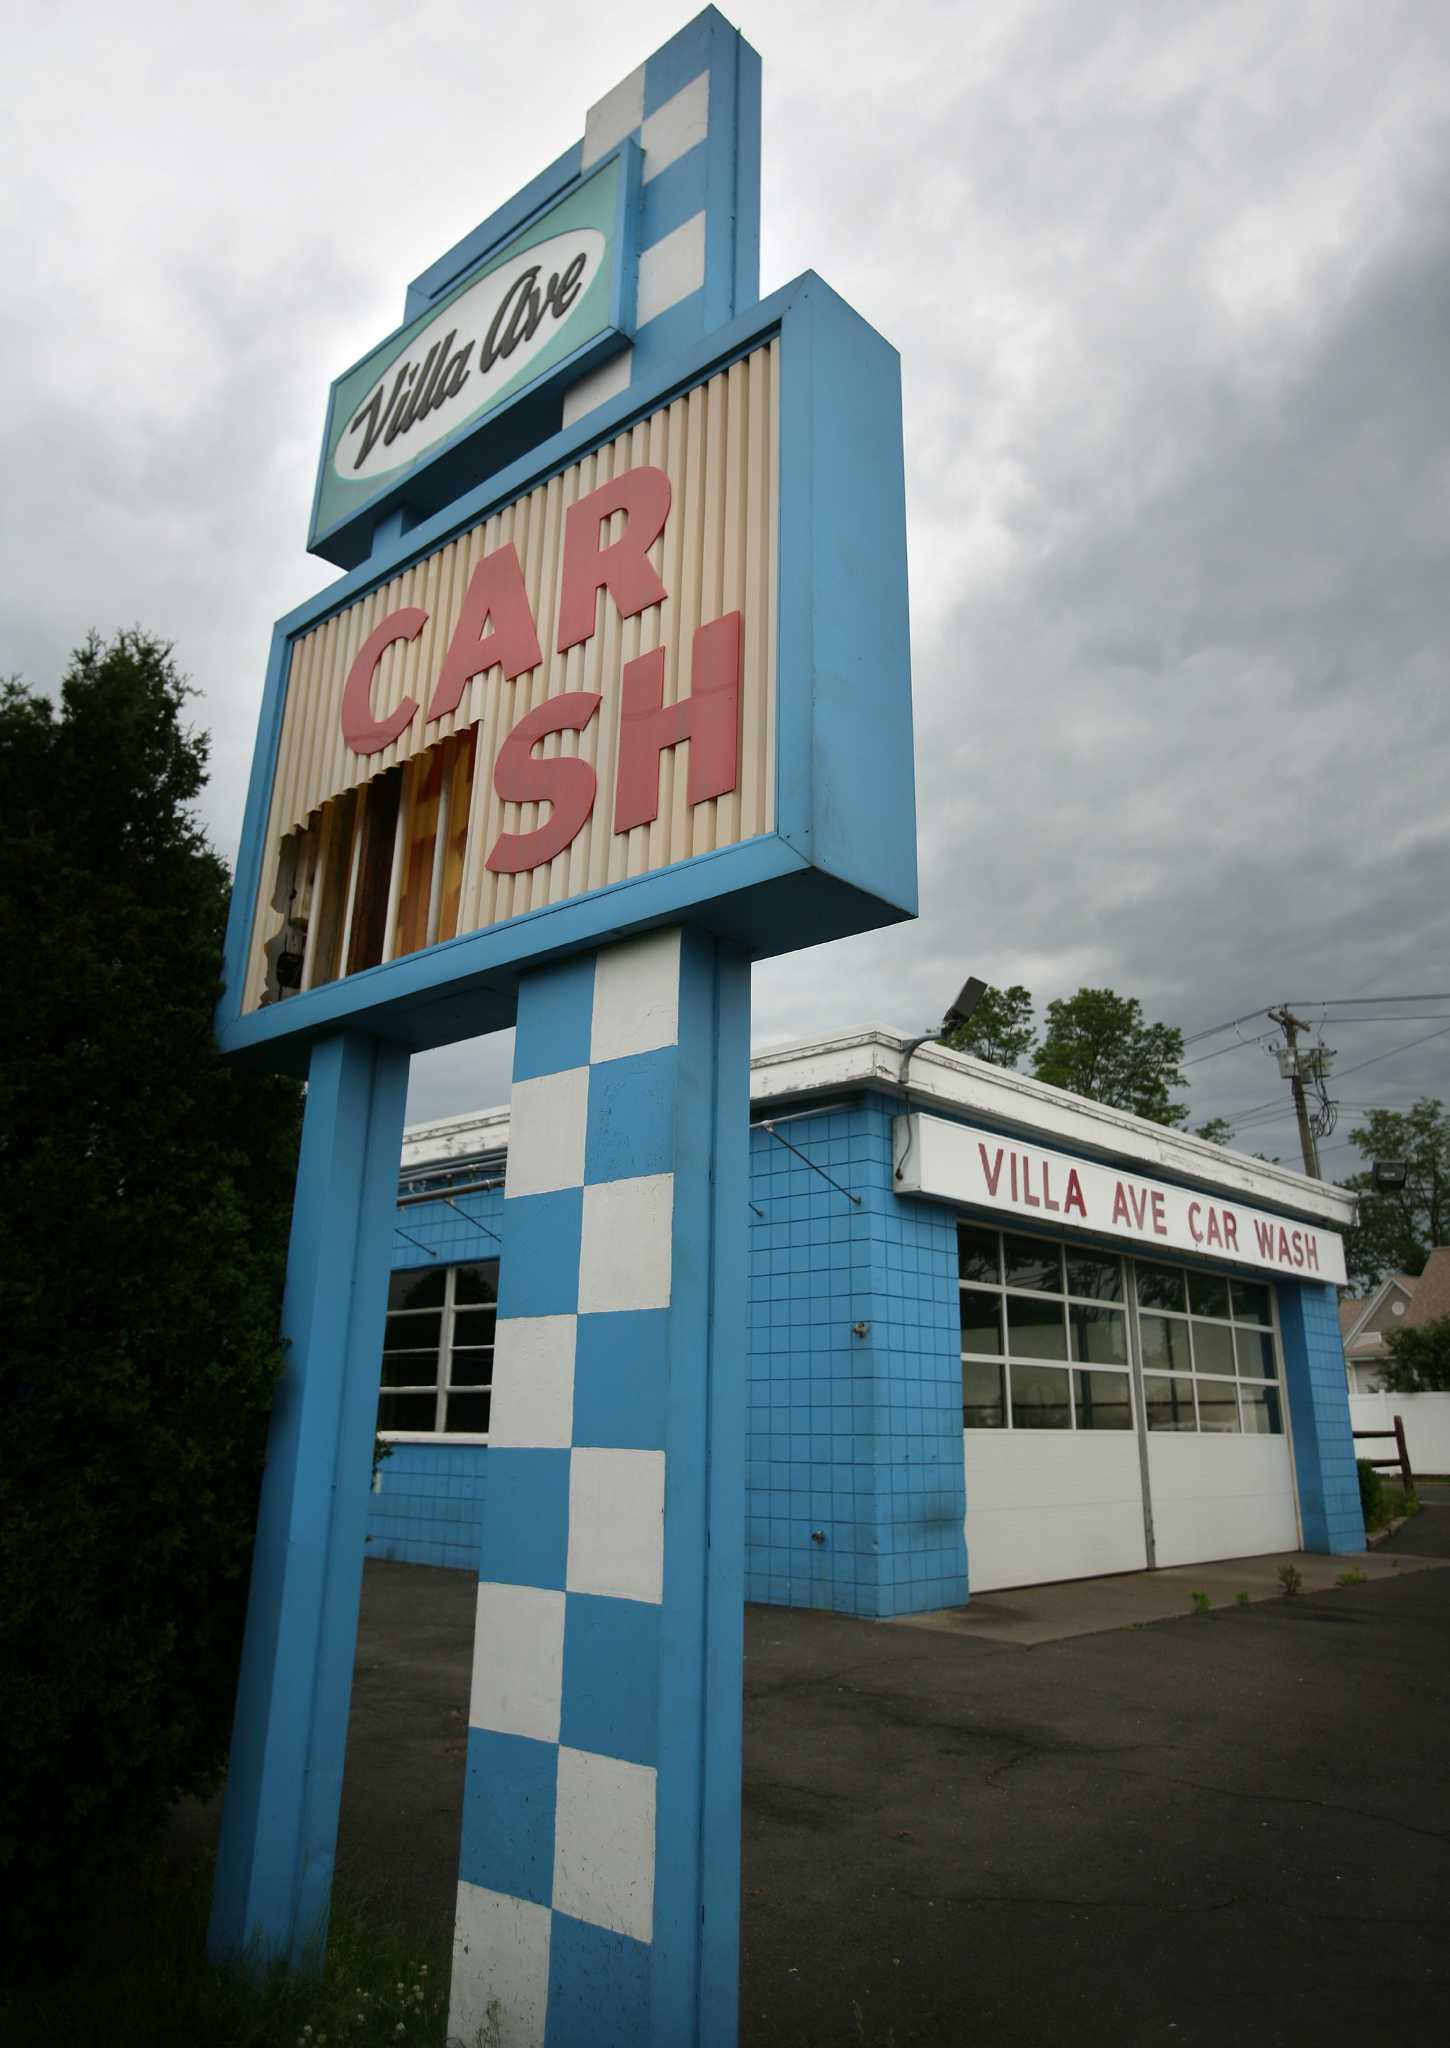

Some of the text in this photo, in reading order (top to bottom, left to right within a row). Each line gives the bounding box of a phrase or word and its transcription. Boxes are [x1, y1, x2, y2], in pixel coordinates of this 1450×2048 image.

[350, 252, 587, 470] Villa Ave
[341, 465, 673, 757] CAR
[978, 1142, 1320, 1272] VILLA AVE CAR WASH
